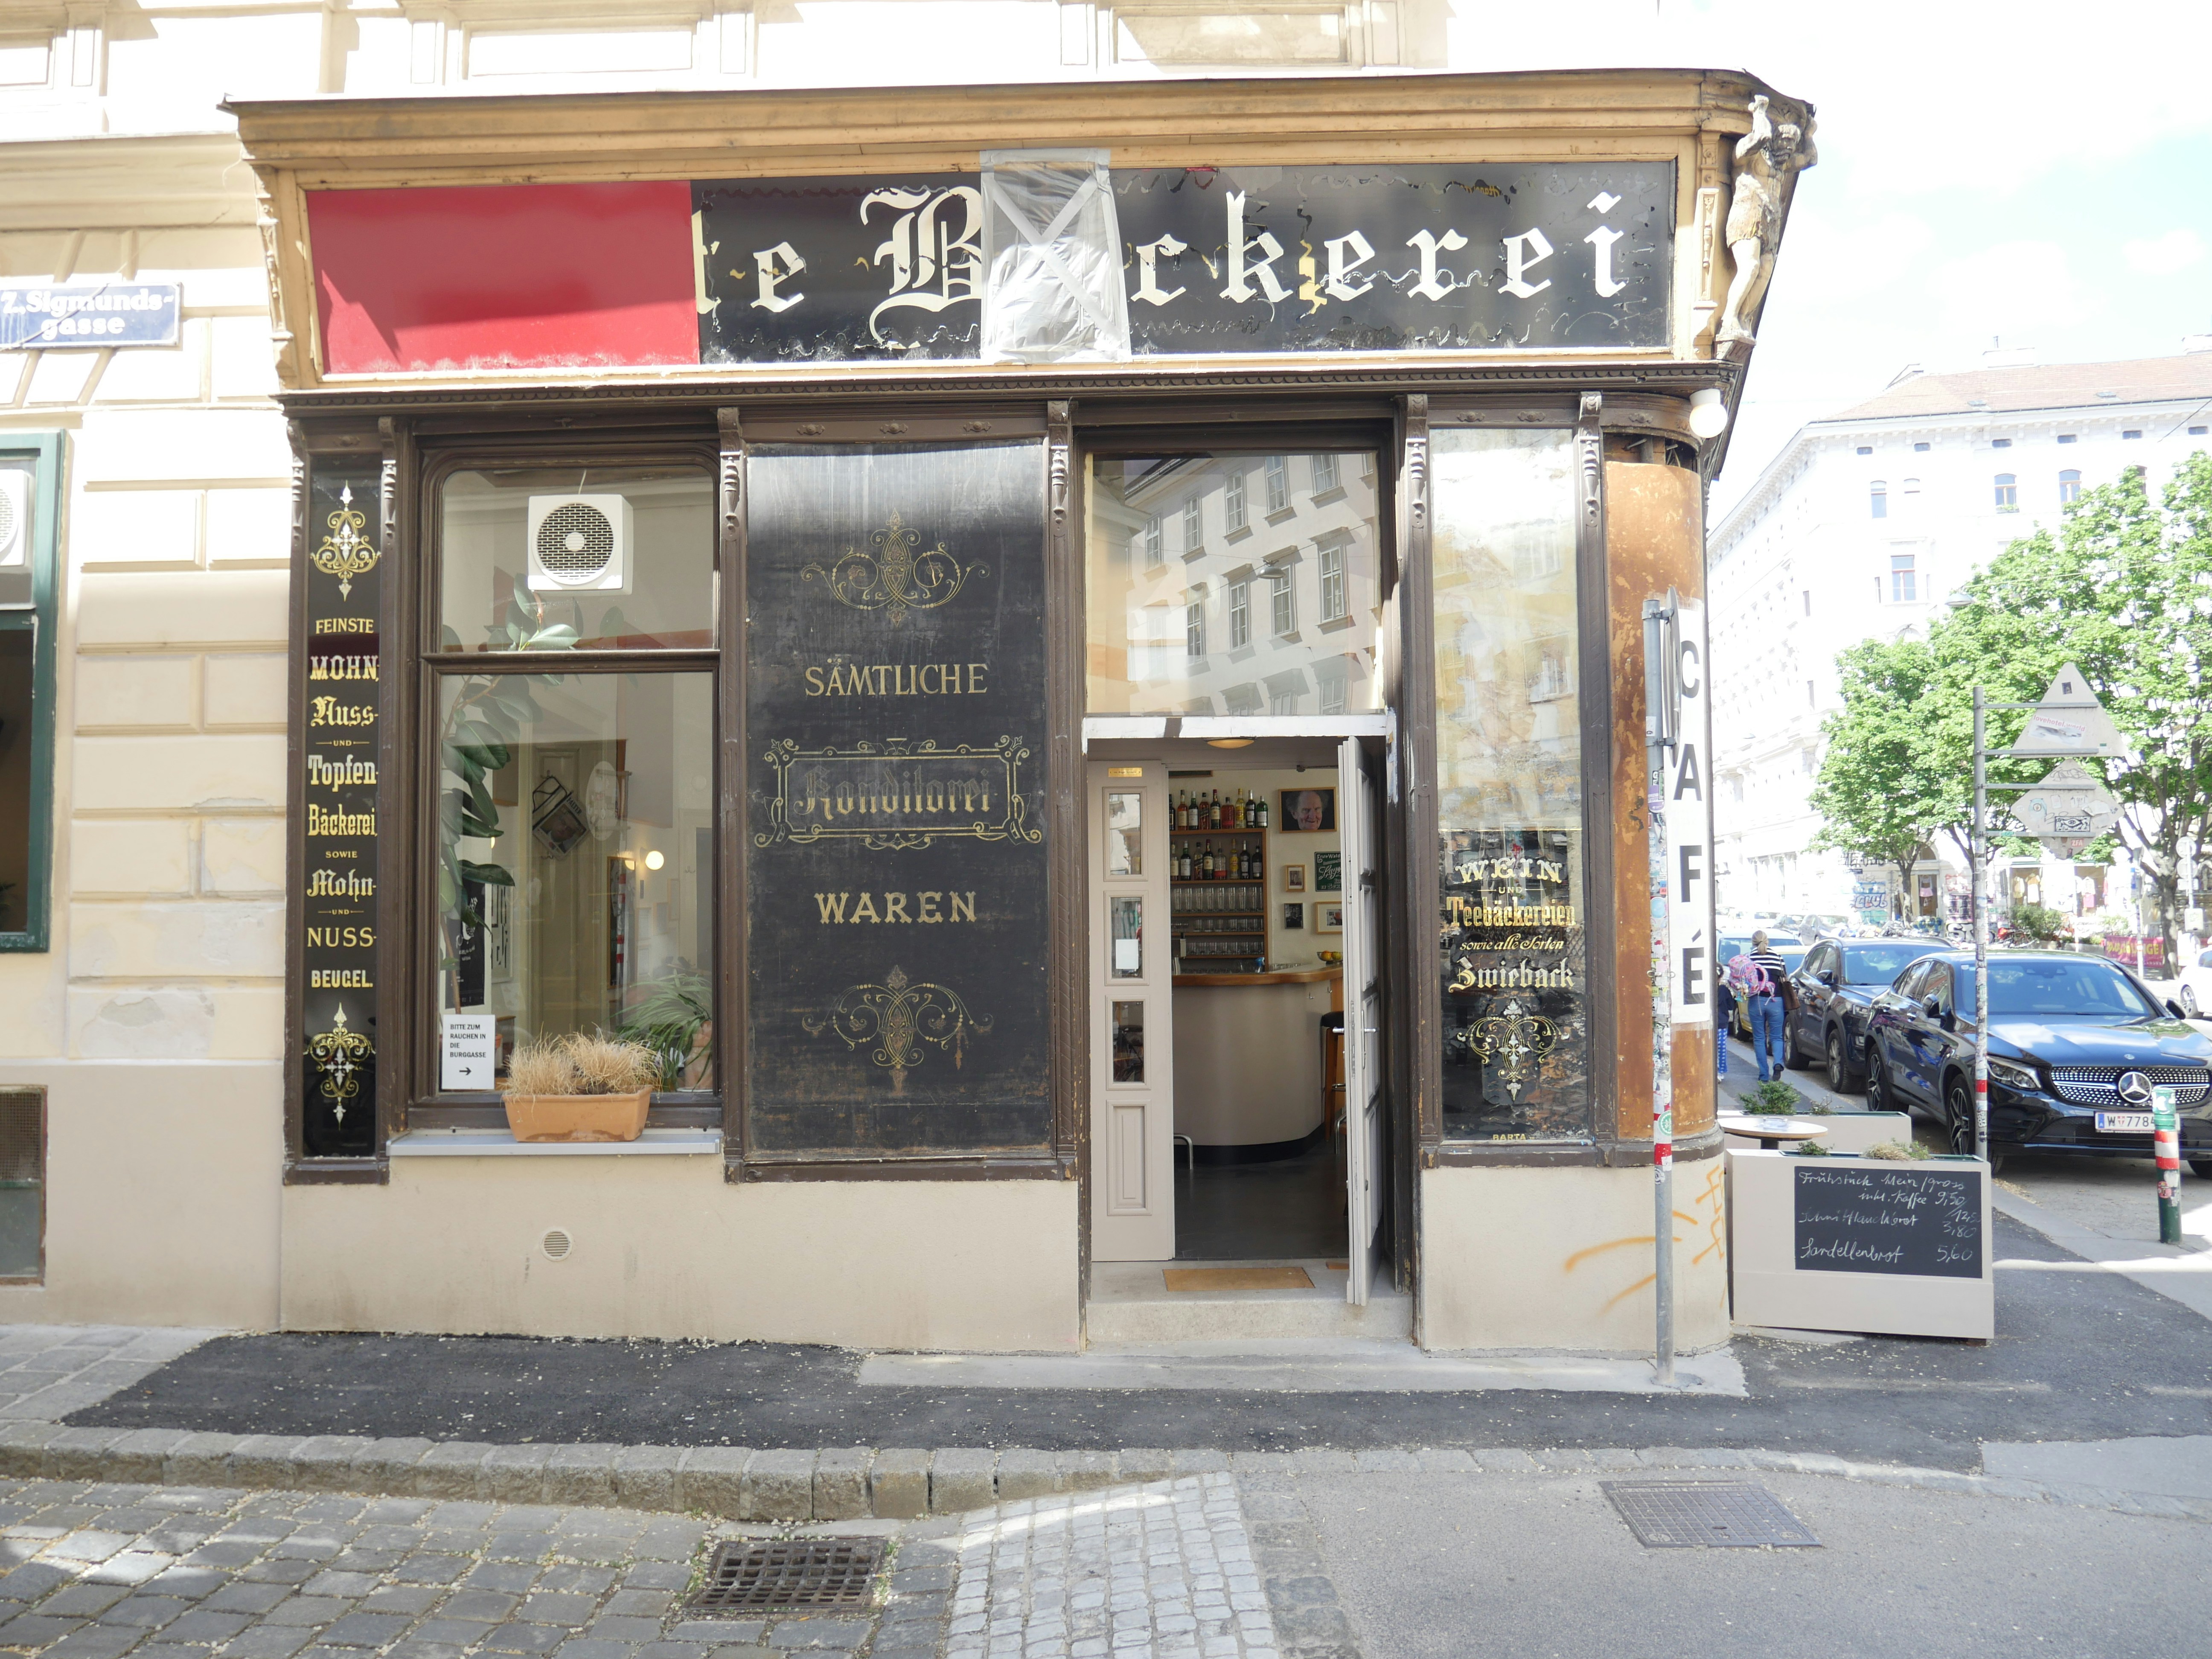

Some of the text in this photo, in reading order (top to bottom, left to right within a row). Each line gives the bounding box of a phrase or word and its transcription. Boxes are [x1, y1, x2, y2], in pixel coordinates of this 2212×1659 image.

[859, 186, 1627, 350] Bckerei
[26, 288, 175, 318] Sigmunds-
[41, 317, 125, 341] gasse
[316, 618, 374, 634] FEINSTE
[805, 658, 989, 696] SÄMTLICHE
[310, 696, 378, 727] Nuss-
[308, 754, 379, 792] Topfen-
[793, 766, 990, 821] Konditorei
[308, 803, 378, 838] Bäckerei,
[1673, 639, 1706, 1005] CAFÉ
[325, 851, 358, 859] SOWIE
[1455, 857, 1563, 884] WEIN
[814, 890, 977, 924] WAREN
[1446, 896, 1577, 927] Teebäckereien
[307, 927, 377, 948] NUSS-
[1459, 933, 1564, 951] sowie alle Sorten
[1448, 957, 1576, 993] Zwieback
[1799, 1171, 1874, 1186] Frühstück
[1891, 1189, 1927, 1210] Kaffee
[1942, 1221, 1977, 1238] 3,80
[1800, 1237, 1904, 1263] Sardellenbrot
